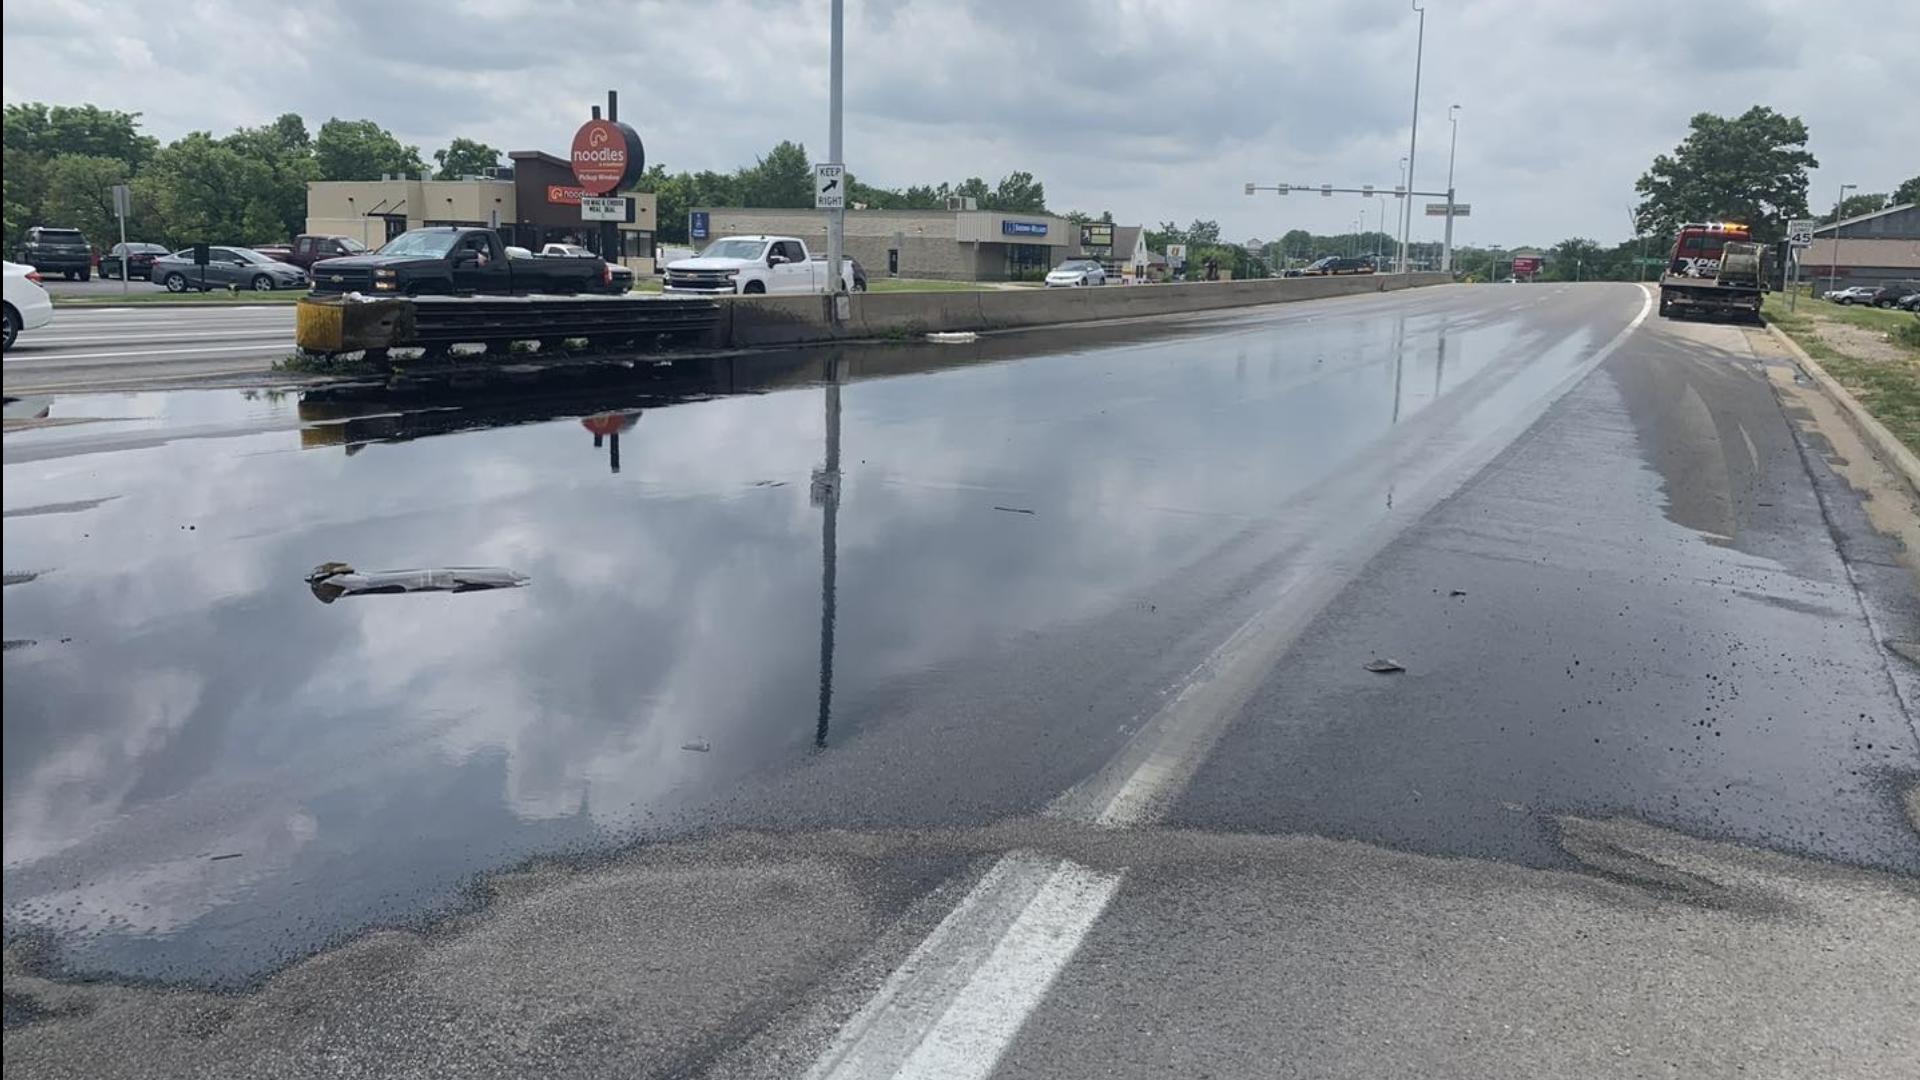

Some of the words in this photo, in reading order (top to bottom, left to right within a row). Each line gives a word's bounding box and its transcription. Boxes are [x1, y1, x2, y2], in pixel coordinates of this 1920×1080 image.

[574, 147, 624, 161] noodles
[819, 167, 841, 176] KEEP
[818, 196, 842, 206] RIGHT
[1791, 233, 1811, 243] 45
